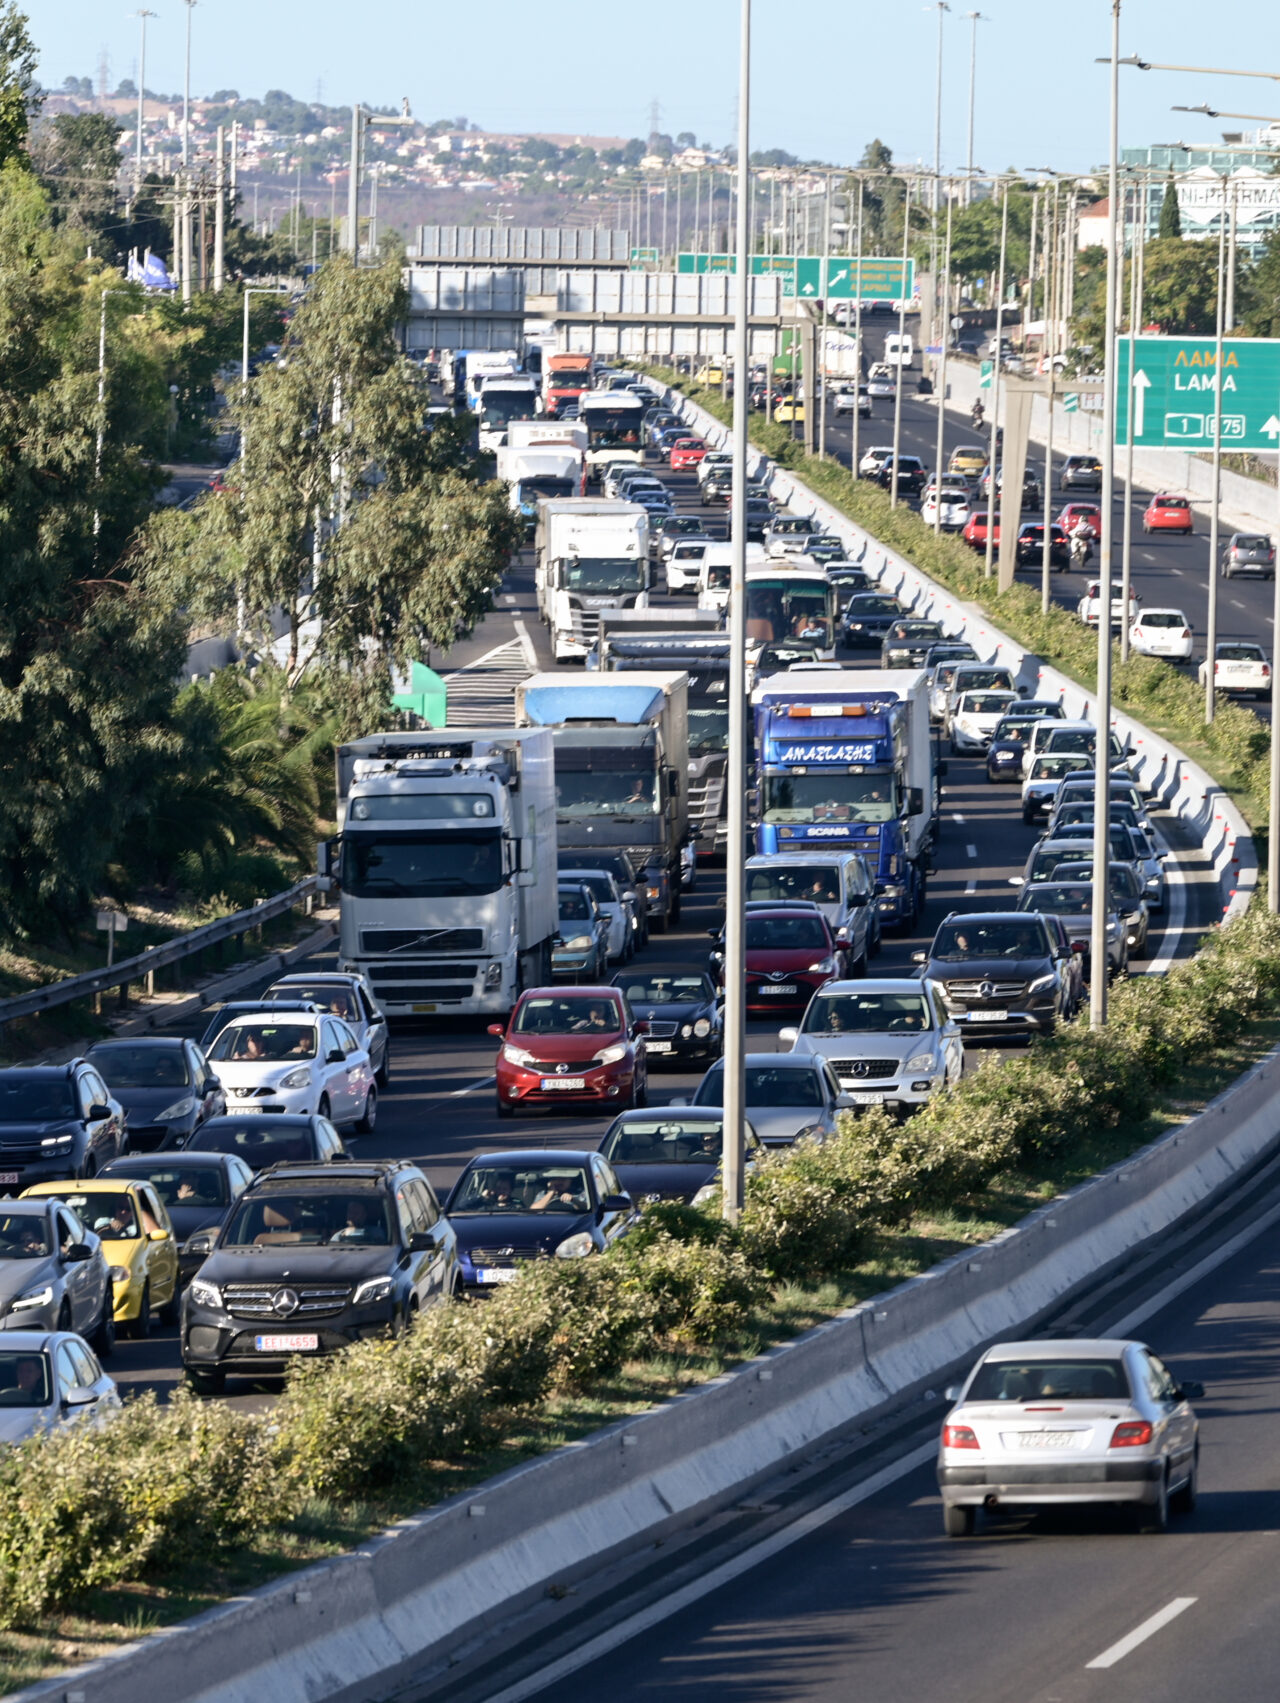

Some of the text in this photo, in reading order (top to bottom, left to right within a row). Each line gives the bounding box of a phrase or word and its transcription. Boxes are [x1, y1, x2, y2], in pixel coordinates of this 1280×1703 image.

[1174, 373, 1237, 392] LAMA
[406, 750, 451, 760] CARRIER
[807, 827, 850, 837] SCANIA
